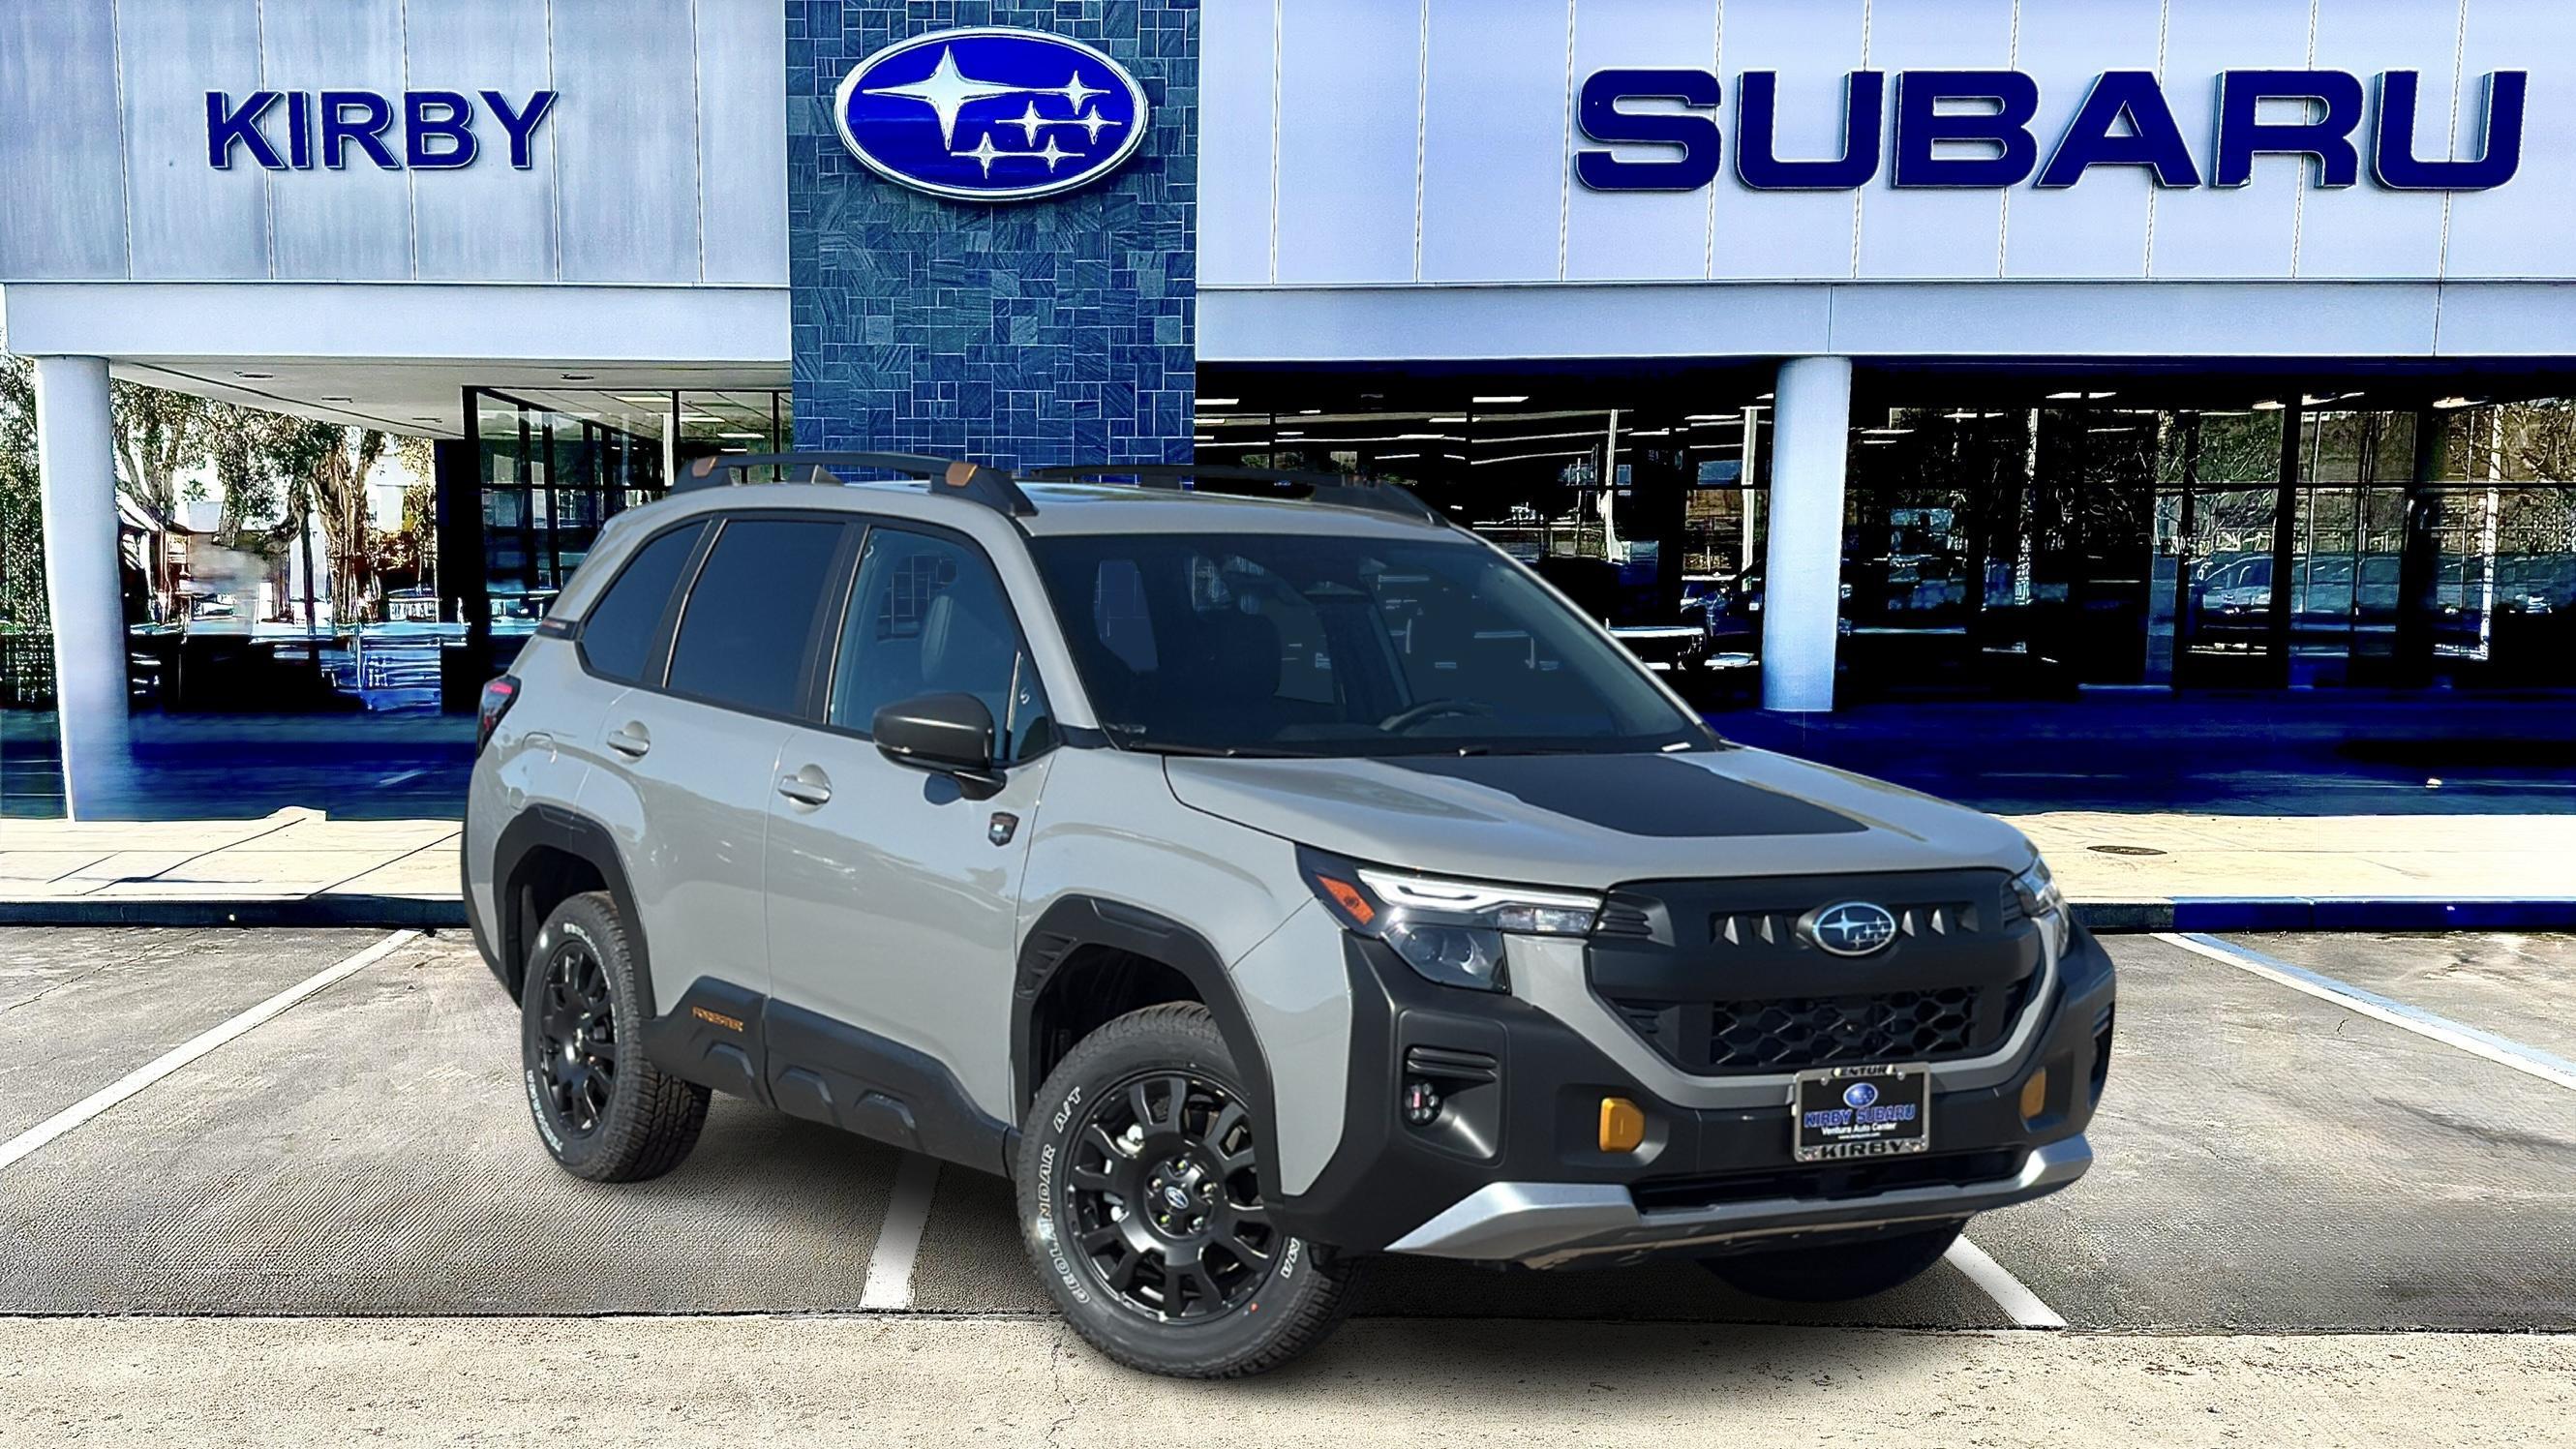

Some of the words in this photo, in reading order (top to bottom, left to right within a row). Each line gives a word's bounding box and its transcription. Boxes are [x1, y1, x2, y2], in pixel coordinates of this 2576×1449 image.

[204, 89, 559, 170] KIRBY
[1575, 69, 2528, 192] SUBARU
[1053, 1086, 1081, 1133] A/T
[1803, 1109, 1853, 1128] KIRBY
[1857, 1104, 1915, 1123] SUBARU
[1822, 1126, 1851, 1135] Ventura
[1853, 1124, 1870, 1132] Auto
[1871, 1122, 1897, 1131] Center
[1822, 1141, 1904, 1158] KIRBY
